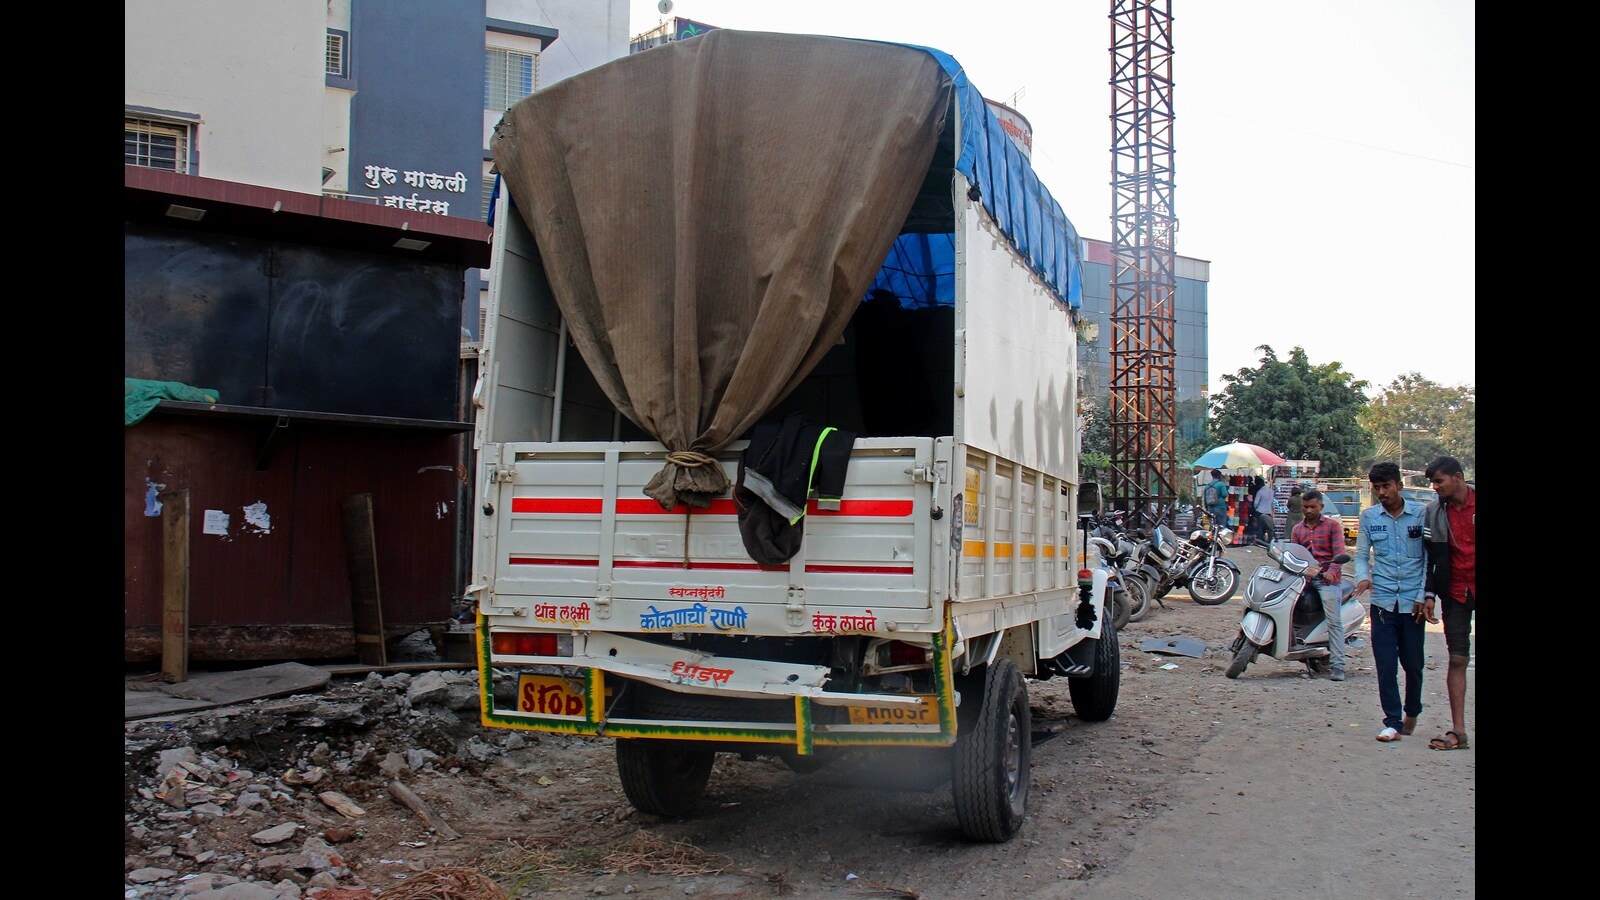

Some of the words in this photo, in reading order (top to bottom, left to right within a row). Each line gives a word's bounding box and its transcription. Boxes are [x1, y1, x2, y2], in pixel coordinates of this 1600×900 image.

[364, 165, 398, 189] गुरु
[403, 171, 468, 193] माऊली
[669, 586, 726, 602] स्वप्नसुंदरी
[559, 601, 591, 625] लक्ष्मी
[640, 602, 708, 630] कोकणची
[709, 605, 749, 632] राणी
[840, 609, 878, 633] लावते
[672, 660, 735, 687] धाडस
